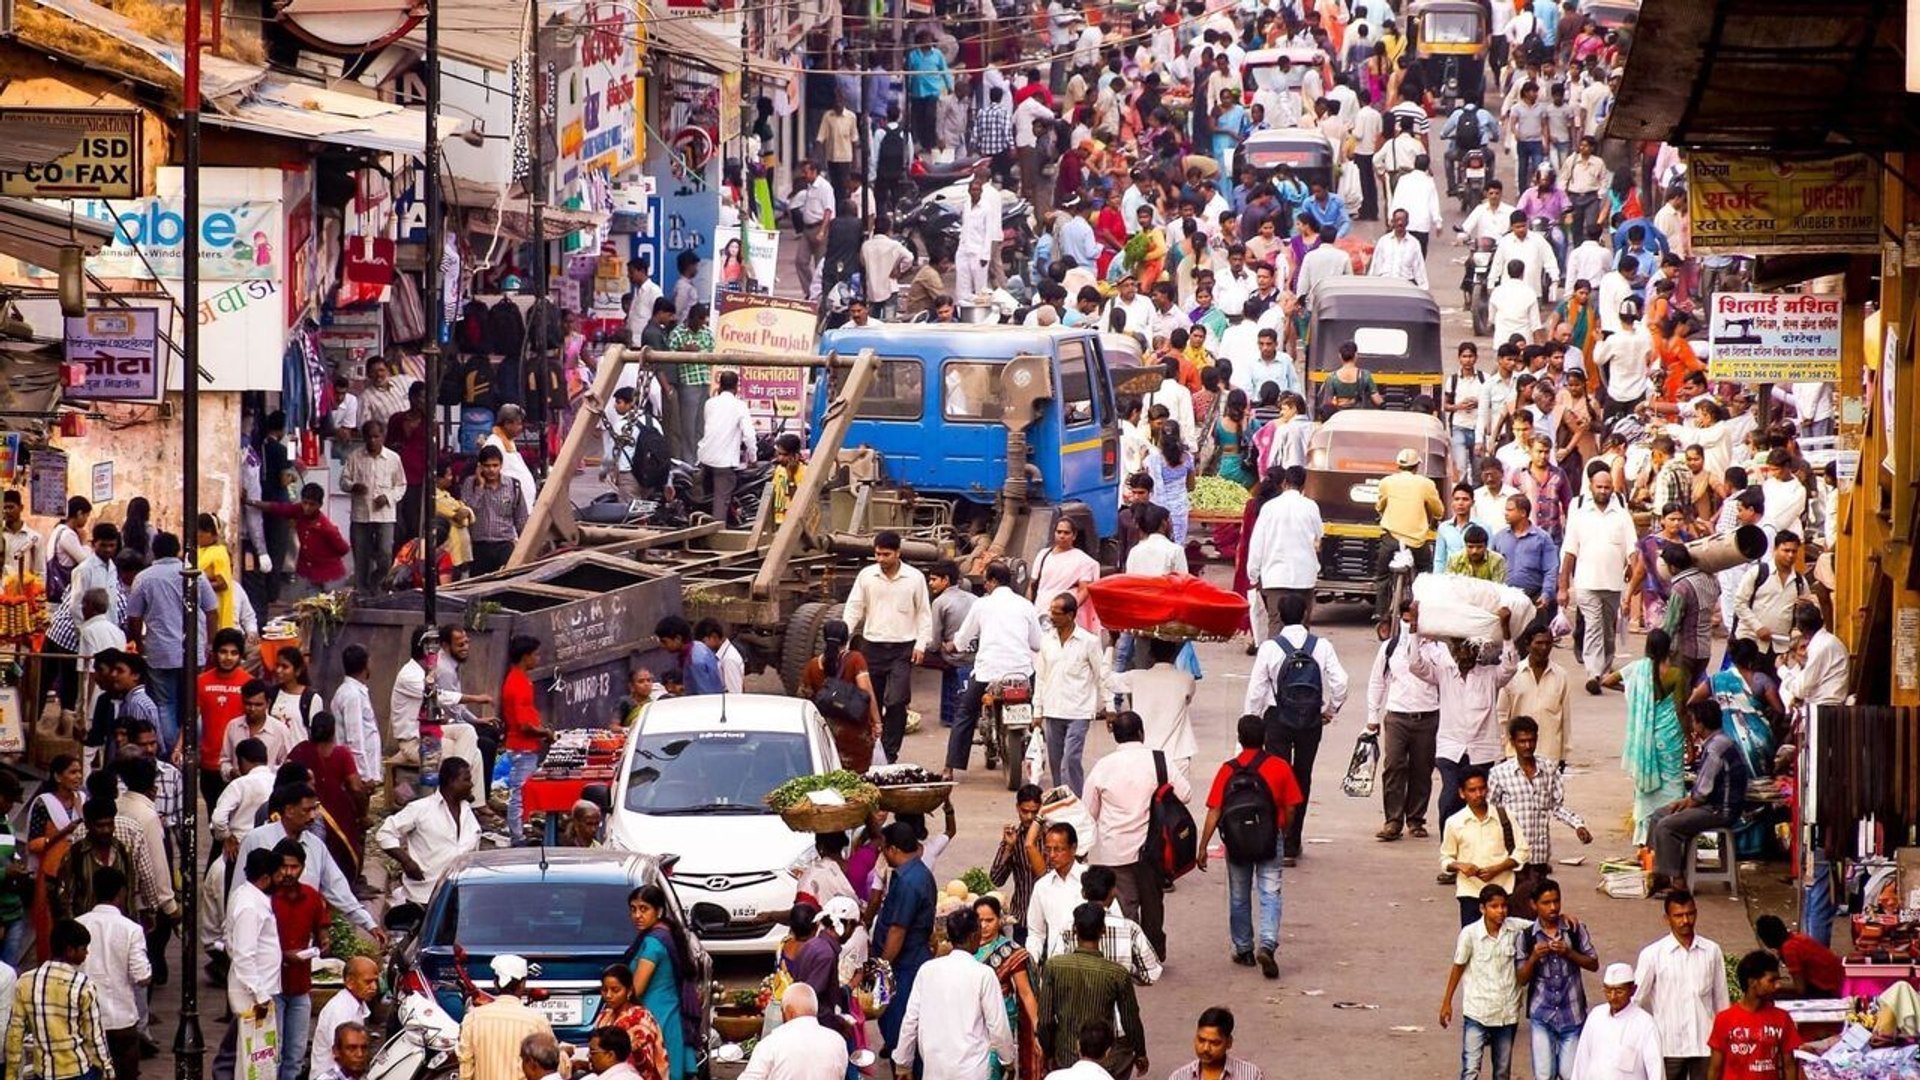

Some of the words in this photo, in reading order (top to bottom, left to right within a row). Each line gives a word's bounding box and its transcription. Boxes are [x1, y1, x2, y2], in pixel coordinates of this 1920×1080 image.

[83, 139, 128, 158] ISD
[76, 164, 129, 184] FAX
[1802, 185, 1865, 210] URGENT
[1793, 215, 1835, 229] RUBBER
[1839, 215, 1874, 229] STAMP
[1718, 295, 1779, 314] शिलाई
[1783, 295, 1839, 314] मशिन
[721, 324, 757, 341] Great
[762, 329, 810, 351] Punjab
